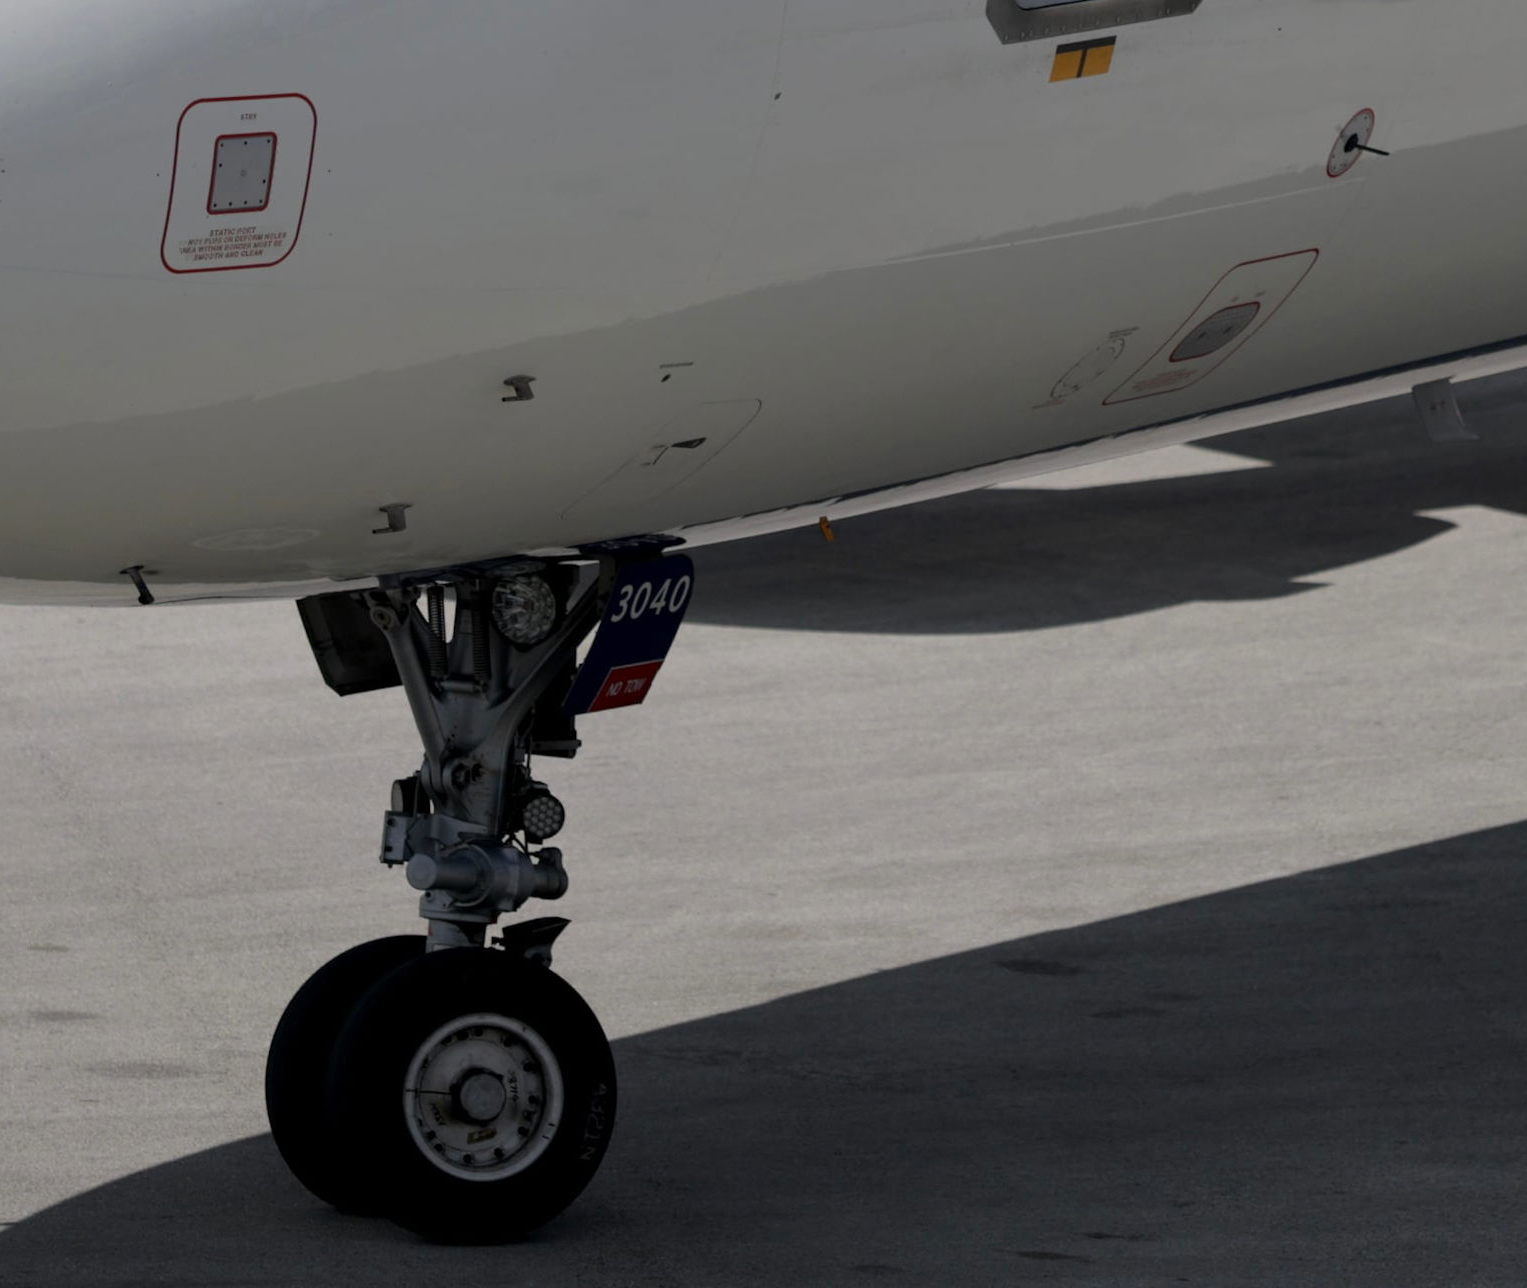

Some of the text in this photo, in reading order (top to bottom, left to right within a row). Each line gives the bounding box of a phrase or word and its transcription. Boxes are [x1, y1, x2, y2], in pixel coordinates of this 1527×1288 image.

[209, 228, 235, 238] STATIC
[610, 574, 691, 624] 3040
[606, 677, 647, 697] NO TOW
